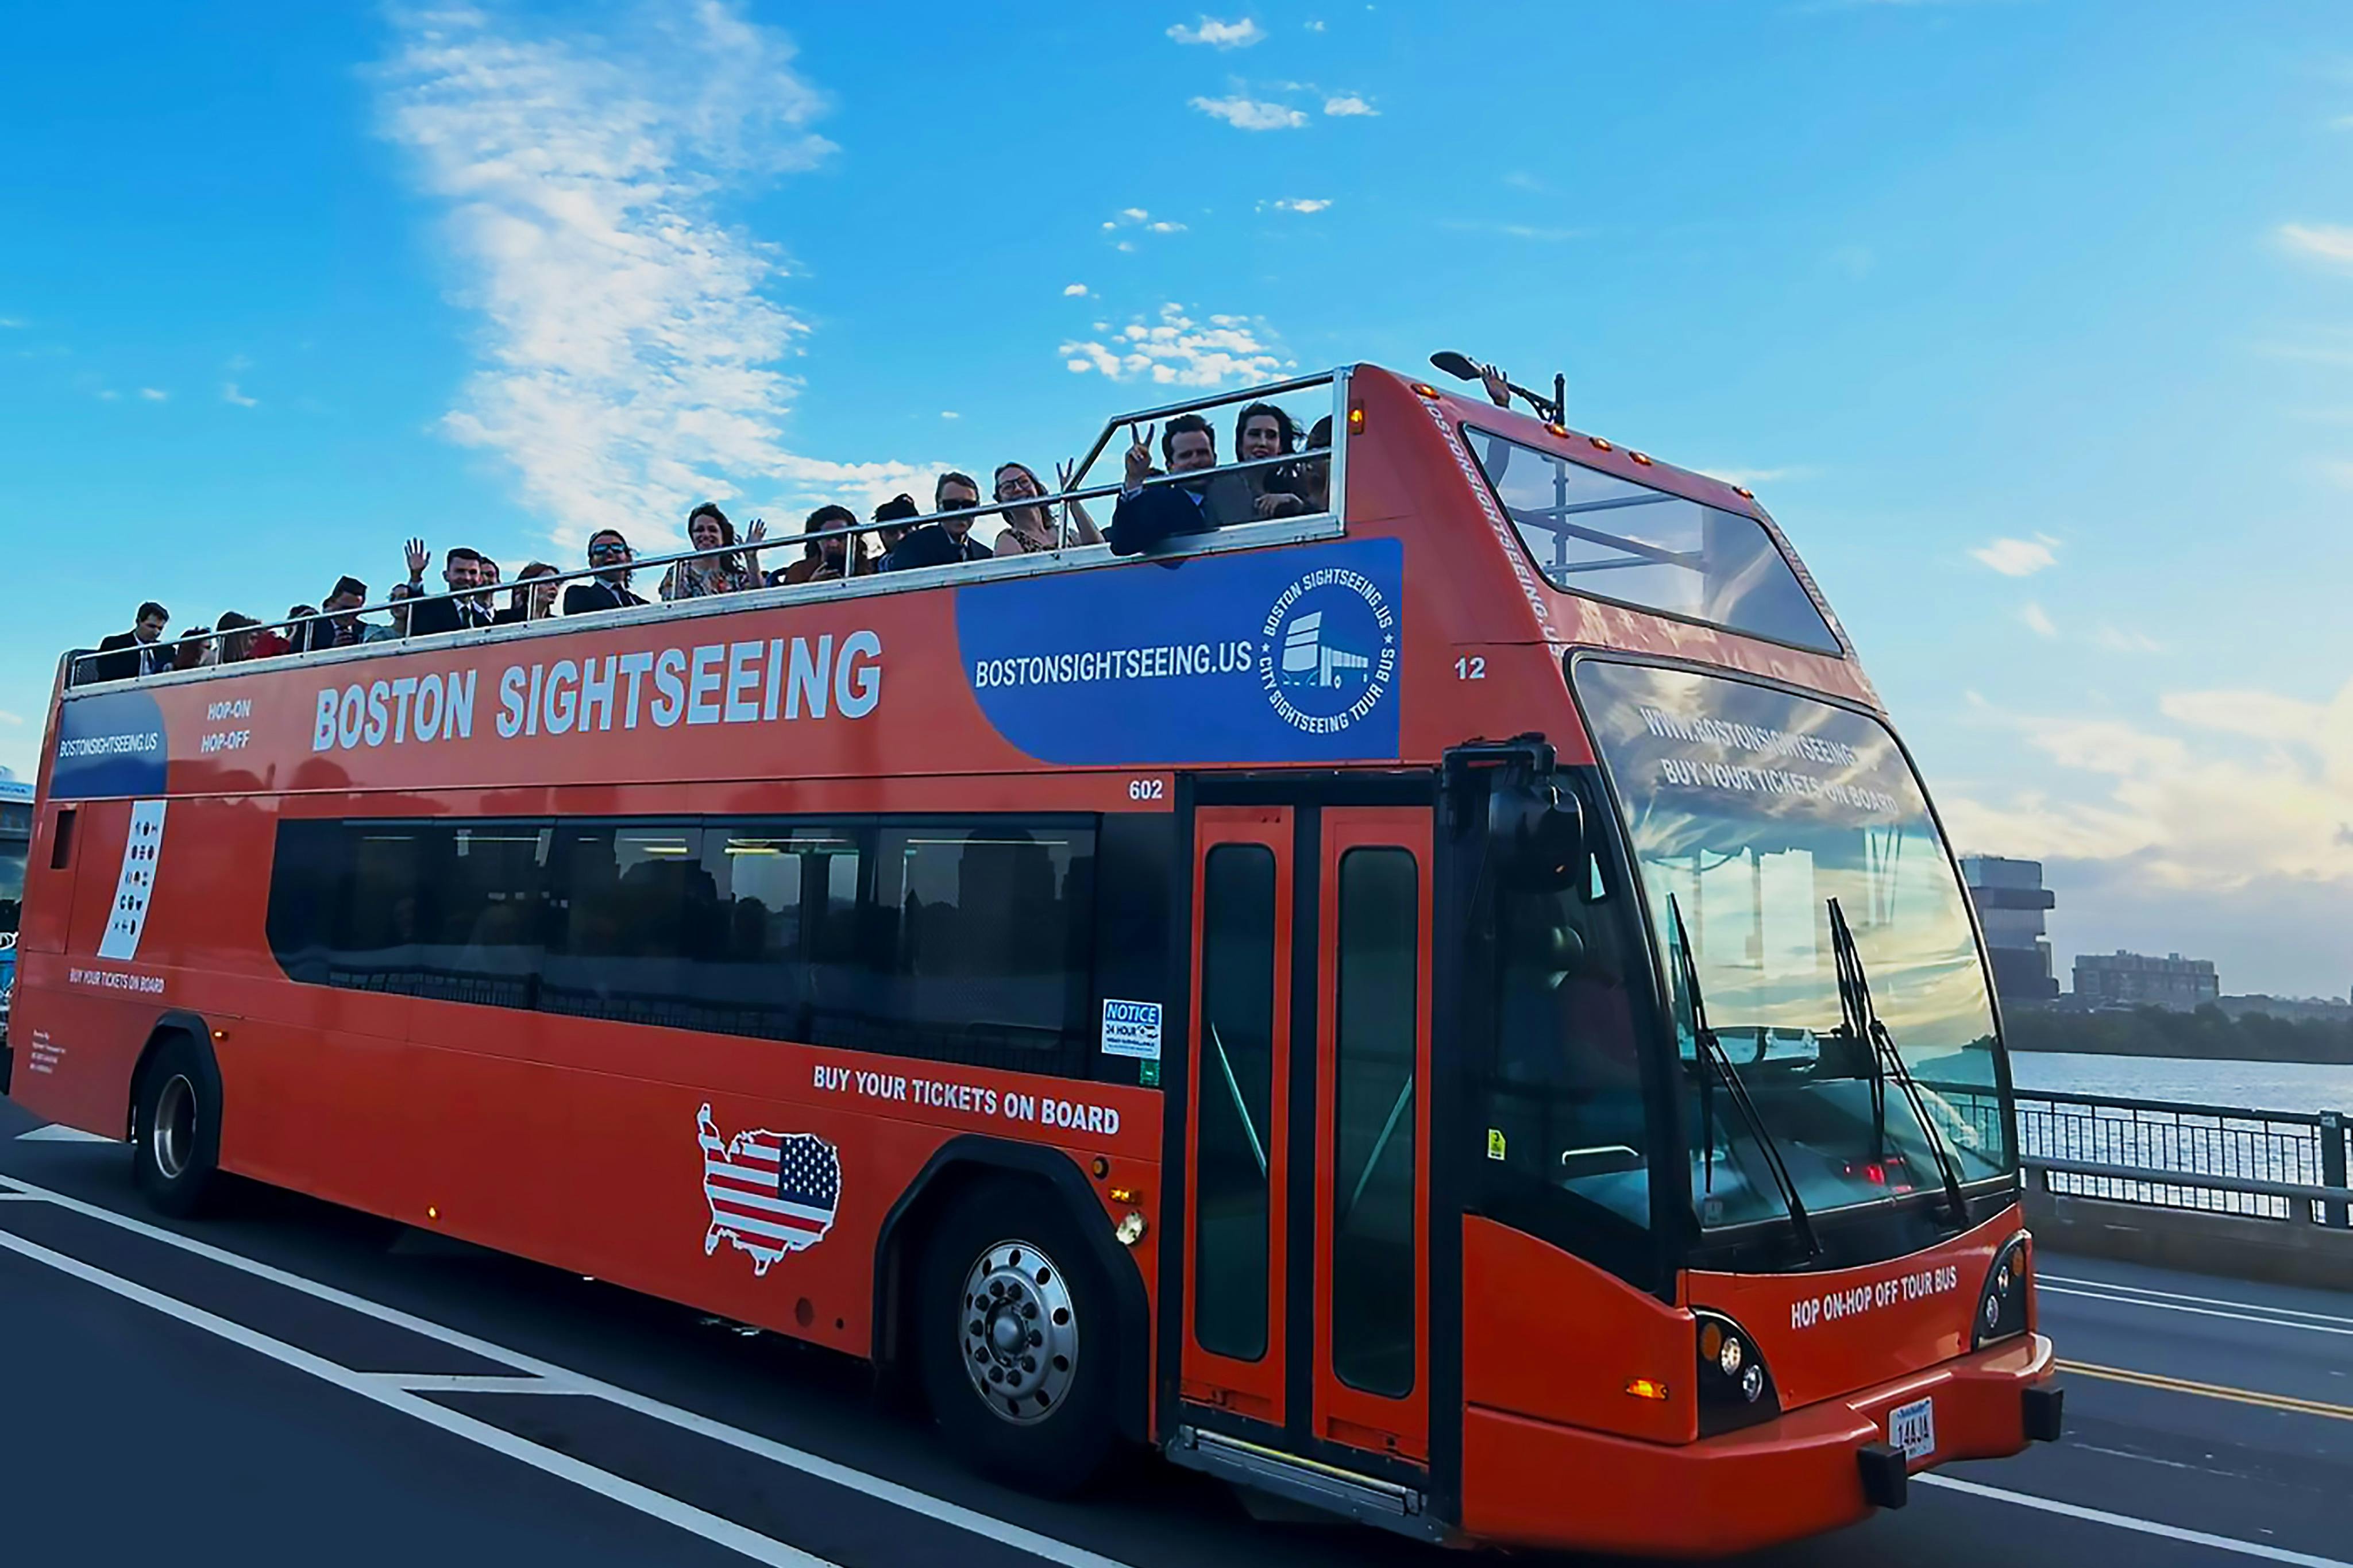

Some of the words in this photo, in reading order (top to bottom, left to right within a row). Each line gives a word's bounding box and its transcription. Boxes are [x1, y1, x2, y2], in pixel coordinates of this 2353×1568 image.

[1263, 582, 1302, 636] BOSTON
[1302, 568, 1392, 628] SIGHTSEEING.US
[975, 640, 1252, 688] BOSTONSIGHTSEEING.US
[1455, 657, 1485, 679] 12
[207, 698, 252, 721] HOP-ON
[312, 669, 476, 751] BOSTON
[496, 630, 882, 739] SIGHTSEEING
[1259, 656, 1277, 690] CITY
[1269, 690, 1349, 733] SIGHTSEEING
[1349, 683, 1384, 721] TOUR
[1375, 648, 1395, 682] BUS
[200, 729, 250, 753] HOP-OFF
[1129, 779, 1163, 800] 602
[1661, 758, 1701, 786] BUY
[1703, 762, 1756, 792] YOUR
[1756, 770, 1823, 798] TICKETS
[1825, 781, 1850, 804] ON
[1106, 1003, 1157, 1022] NOTICE
[813, 1065, 850, 1091] BUY
[856, 1071, 906, 1101] YOUR
[912, 1079, 997, 1115] TICKETS
[1004, 1092, 1034, 1121] ON
[1041, 1098, 1120, 1136] BOARD
[1791, 1299, 1820, 1330] HOP
[1823, 1285, 1872, 1320] ON-HOP
[1875, 1280, 1898, 1307] OFF
[1901, 1270, 1933, 1301] TOUR
[1935, 1265, 1957, 1292] BUS
